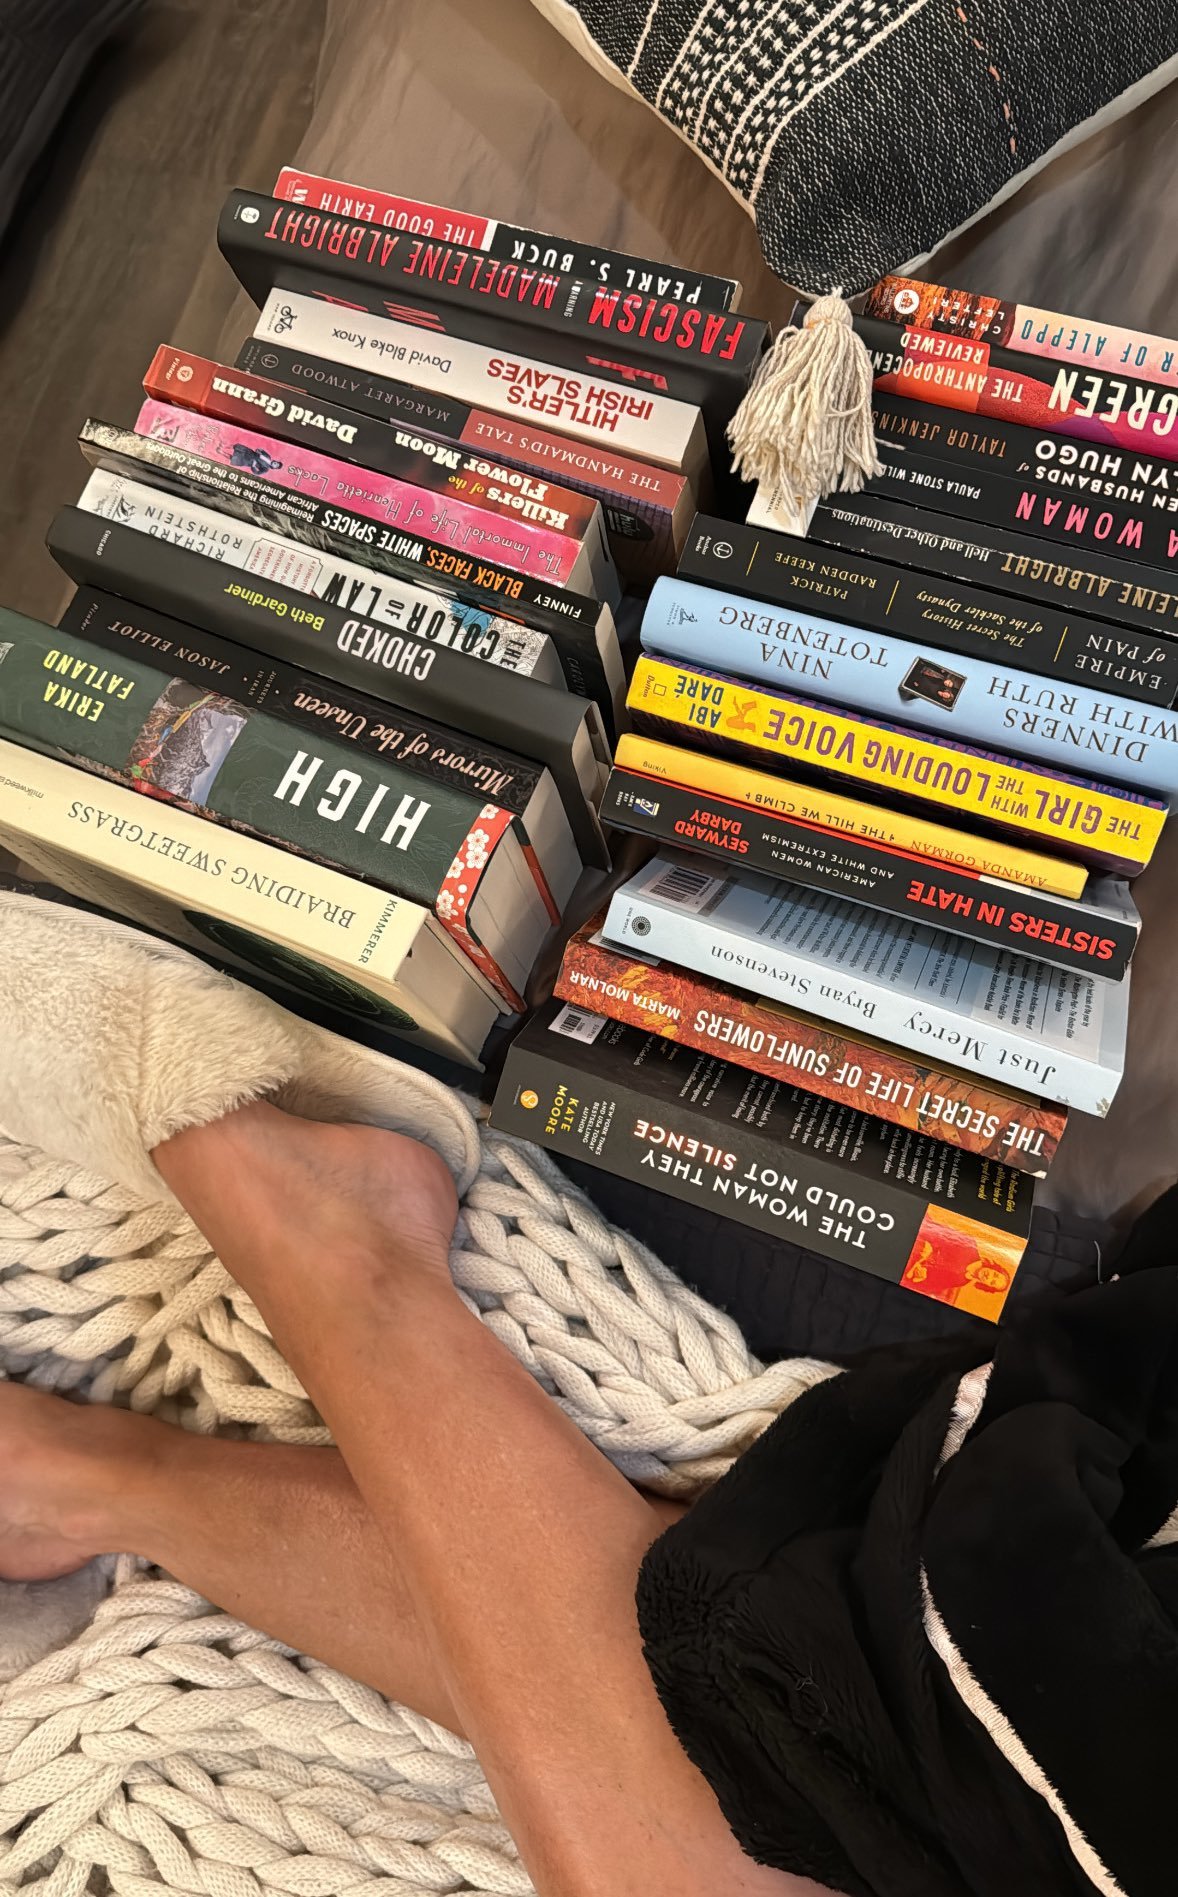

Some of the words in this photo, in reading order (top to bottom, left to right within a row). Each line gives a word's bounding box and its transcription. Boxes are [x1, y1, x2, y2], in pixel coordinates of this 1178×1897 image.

[264, 207, 399, 266] ALBRIGHT
[511, 240, 574, 272] BUCK
[590, 259, 610, 281] S.
[403, 240, 560, 308] MADELEINE
[626, 268, 701, 304] PEARL
[588, 285, 745, 359] FASCISM
[924, 308, 1001, 334] CHRISTY
[930, 295, 1006, 320] LEFTERI
[331, 328, 366, 349] Knox
[370, 339, 406, 360] Blake
[897, 330, 983, 364] REVIEWED
[408, 350, 451, 373] David
[291, 364, 360, 391] ATWOOD
[486, 358, 581, 399] SLAVES
[990, 378, 1023, 402] THE
[212, 377, 284, 416] Grann
[363, 387, 450, 421] MARGARET
[506, 385, 620, 432] HITLER'S
[585, 385, 653, 420] IRISH
[1047, 368, 1178, 435] GREEN
[286, 404, 357, 443] David
[475, 422, 513, 444] TALE
[145, 440, 186, 464] Outdoors
[186, 455, 211, 473] Great
[395, 431, 461, 469] Moon
[519, 437, 623, 479] HANDMAID'S
[175, 465, 187, 477] of
[187, 468, 241, 495] Relationship
[212, 466, 227, 477] the
[227, 471, 239, 482] to
[283, 463, 329, 495] Lacks
[446, 473, 467, 489] the
[463, 455, 548, 501] Flower
[628, 472, 659, 491] THE
[909, 471, 944, 489] STONE
[239, 476, 286, 499] Americans
[242, 489, 258, 501] the
[284, 493, 319, 511] African
[333, 480, 402, 520] Henrietta
[467, 481, 485, 496] of
[946, 480, 980, 499] PAULA
[258, 494, 314, 522] Reimagining
[401, 499, 424, 524] of
[486, 487, 569, 530] Killers
[1015, 491, 1142, 548] WOMAN
[144, 505, 242, 549] ROTHSTEIN
[321, 509, 376, 543] SPACES
[424, 509, 459, 540] Life
[831, 508, 903, 538] Destinations
[904, 528, 939, 547] Other
[96, 529, 111, 555] CHICAGO
[145, 525, 223, 561] RICHARD
[376, 530, 423, 561] WHITE
[461, 524, 530, 564] Immortal
[939, 537, 964, 551] and
[964, 544, 990, 561] Hell
[426, 545, 473, 579] FACES,
[537, 549, 563, 576] The
[774, 552, 815, 571] KEEFE
[472, 566, 523, 598] BLACK
[789, 575, 848, 599] PATRICK
[819, 565, 877, 588] RADDEN
[223, 583, 287, 616] Gardiner
[318, 570, 383, 618] LAW
[533, 593, 581, 618] FINNEY
[916, 590, 961, 612] Dynasty
[290, 607, 325, 630] Beth
[384, 599, 404, 619] OF
[921, 608, 963, 630] History
[964, 606, 1006, 625] Sackler
[107, 621, 172, 651] ELLIOT
[403, 599, 503, 662] COLOR
[718, 606, 887, 667] TOTENBERG
[965, 623, 1000, 640] Secret
[1007, 617, 1028, 631] the
[1026, 620, 1043, 635] of
[336, 619, 436, 680] CHOKED
[499, 639, 526, 669] THE
[1003, 633, 1024, 647] The
[1085, 634, 1139, 659] PAIN
[173, 647, 230, 674] JASON
[760, 642, 833, 679] NINA
[1142, 647, 1165, 663] of
[43, 649, 134, 699] FATLAND
[642, 674, 655, 697] Dutton
[1074, 654, 1162, 689] EMPIRE
[43, 681, 104, 721] ERIKA
[673, 674, 724, 705] DARÉ
[986, 676, 1077, 715] RUTH
[293, 692, 366, 739] Unseen
[688, 703, 721, 728] ABI
[369, 724, 404, 757] the
[395, 729, 431, 763] of
[762, 708, 855, 763] VOICE
[1003, 708, 1148, 762] DINNERS
[429, 748, 513, 795] Mirrors
[640, 760, 666, 774] Viking
[862, 739, 991, 801] LOUDING
[2, 776, 44, 798] milkweed
[995, 775, 1024, 795] THE
[273, 750, 431, 850] HIGH
[754, 793, 795, 812] CLIMB
[800, 806, 819, 820] WE
[990, 795, 1028, 818] WITH
[1035, 789, 1102, 834] GIRL
[689, 809, 741, 834] DARBY
[826, 814, 854, 830] HILL
[860, 824, 885, 840] THE
[1105, 816, 1140, 840] THE
[67, 801, 226, 875] SWEETGRASS
[674, 820, 749, 853] SEYWARD
[761, 832, 825, 858] EXTREMISM
[771, 850, 811, 868] WOMEN
[830, 854, 865, 870] WHITE
[908, 842, 973, 865] GORMAN
[816, 864, 875, 887] AMERICAN
[870, 866, 894, 878] AND
[979, 861, 1043, 886] AMANDA
[230, 866, 356, 928] BRAIDING
[906, 880, 973, 916] HATE
[976, 901, 1004, 926] IN
[358, 899, 397, 963] KIMMERER
[1008, 912, 1116, 959] SISTERS
[711, 945, 811, 993] Stevenson
[569, 970, 629, 1001] MOLNAR
[632, 992, 680, 1019] MARTA
[819, 985, 875, 1018] Bryan
[693, 1010, 829, 1076] SUNFLOWERS
[903, 1011, 980, 1061] Mercy
[832, 1062, 862, 1087] OF
[999, 1049, 1056, 1084] Just
[864, 1071, 914, 1107] LIFE
[545, 1084, 567, 1134] MOORE
[560, 1097, 579, 1131] KATE
[577, 1106, 589, 1133] AUTHOR
[595, 1113, 603, 1127] USA
[599, 1100, 607, 1114] AND
[607, 1101, 615, 1117] NEW
[915, 1091, 999, 1137] SECRET
[582, 1101, 599, 1143] BESTSELLING
[601, 1116, 612, 1135] YORK
[588, 1129, 599, 1151] TODAY
[594, 1136, 605, 1155] TIMES
[633, 1119, 736, 1170] SILENCE
[1001, 1121, 1044, 1156] THE
[640, 1149, 702, 1185] THEY
[743, 1163, 797, 1194] NOT
[712, 1175, 807, 1226] WOMAN
[805, 1186, 894, 1230] COULD
[818, 1215, 865, 1248] THE
